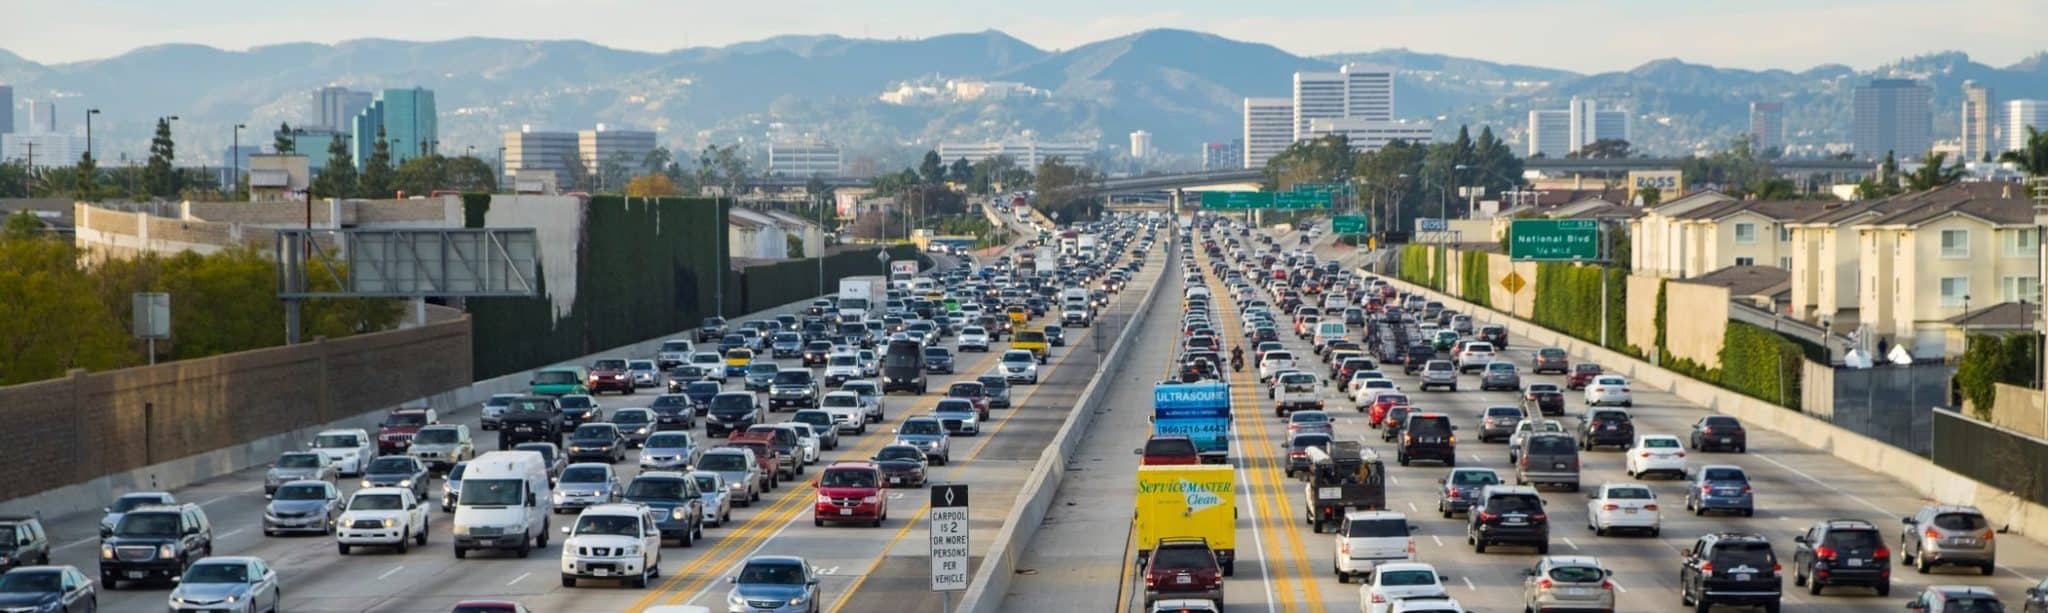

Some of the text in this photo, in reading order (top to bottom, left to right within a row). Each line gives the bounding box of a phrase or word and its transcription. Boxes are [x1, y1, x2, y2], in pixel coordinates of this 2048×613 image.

[1637, 176, 1675, 187] ROSS
[1518, 234, 1591, 243] National Blvd
[1187, 494, 1218, 504] Clean
[933, 512, 966, 520] CARPOOL
[941, 521, 958, 533] IS 2
[933, 536, 966, 545] OR MORE
[933, 548, 966, 557] PERSONS
[943, 561, 956, 570] PER
[935, 574, 964, 584] VEHICLE
